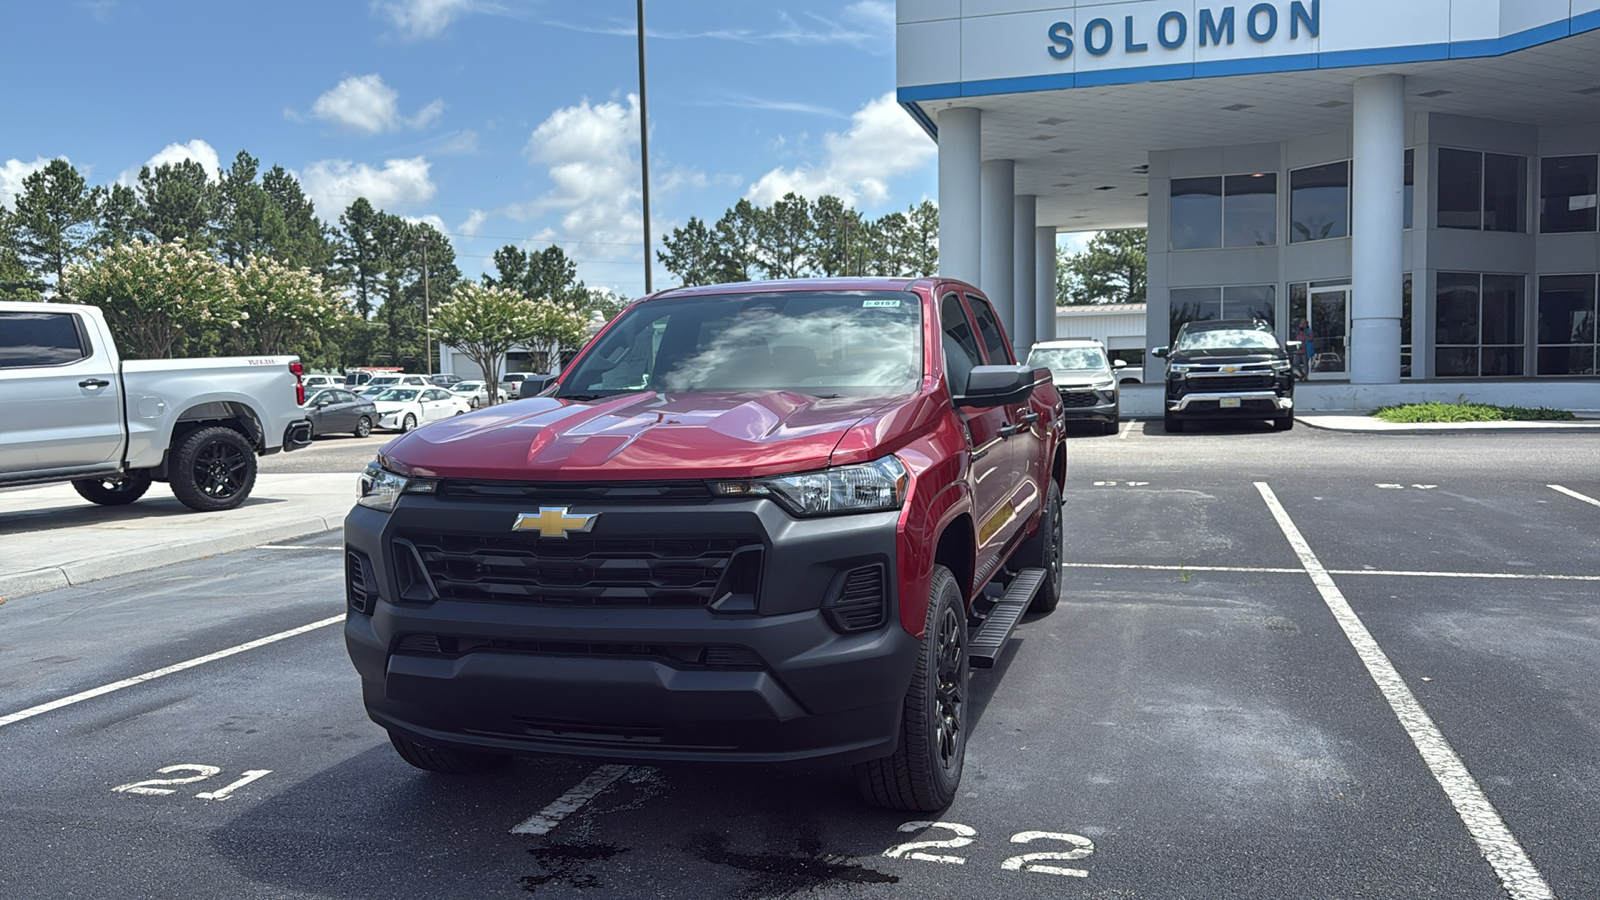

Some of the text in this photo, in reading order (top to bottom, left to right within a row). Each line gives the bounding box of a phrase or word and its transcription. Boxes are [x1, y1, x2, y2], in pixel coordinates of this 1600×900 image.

[1047, 0, 1320, 59] SOLOMON
[110, 764, 273, 800] 21
[881, 820, 1094, 878] 22
